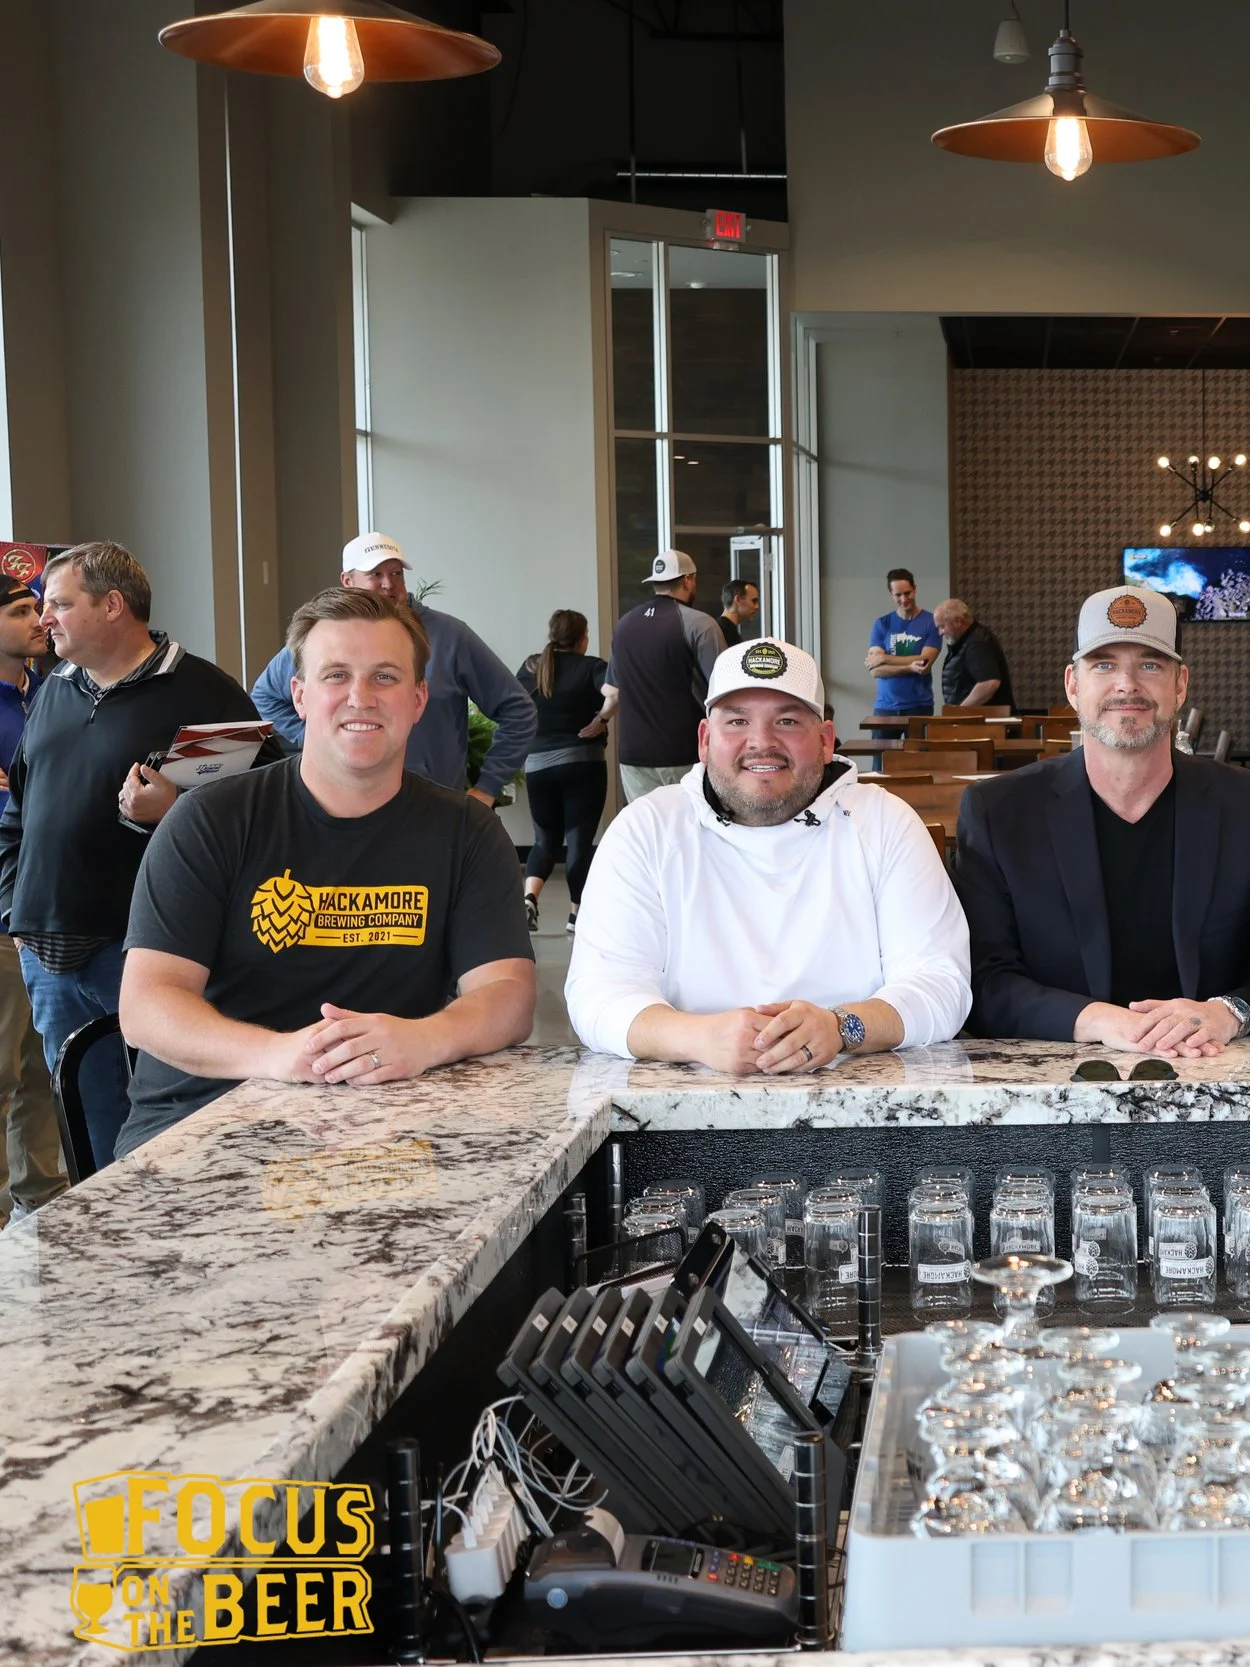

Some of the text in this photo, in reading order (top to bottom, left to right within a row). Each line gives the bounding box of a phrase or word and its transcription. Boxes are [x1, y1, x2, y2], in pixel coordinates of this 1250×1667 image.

[716, 211, 741, 238] EXIT
[644, 607, 656, 617] 41
[748, 656, 781, 665] HACKAMORE
[318, 891, 424, 912] HACKAMORE
[317, 913, 420, 928] BREWING COMPANY
[343, 931, 391, 943] EST. 2021
[923, 1270, 963, 1280] HACKAMORE
[1165, 1267, 1204, 1275] HACKAMORE
